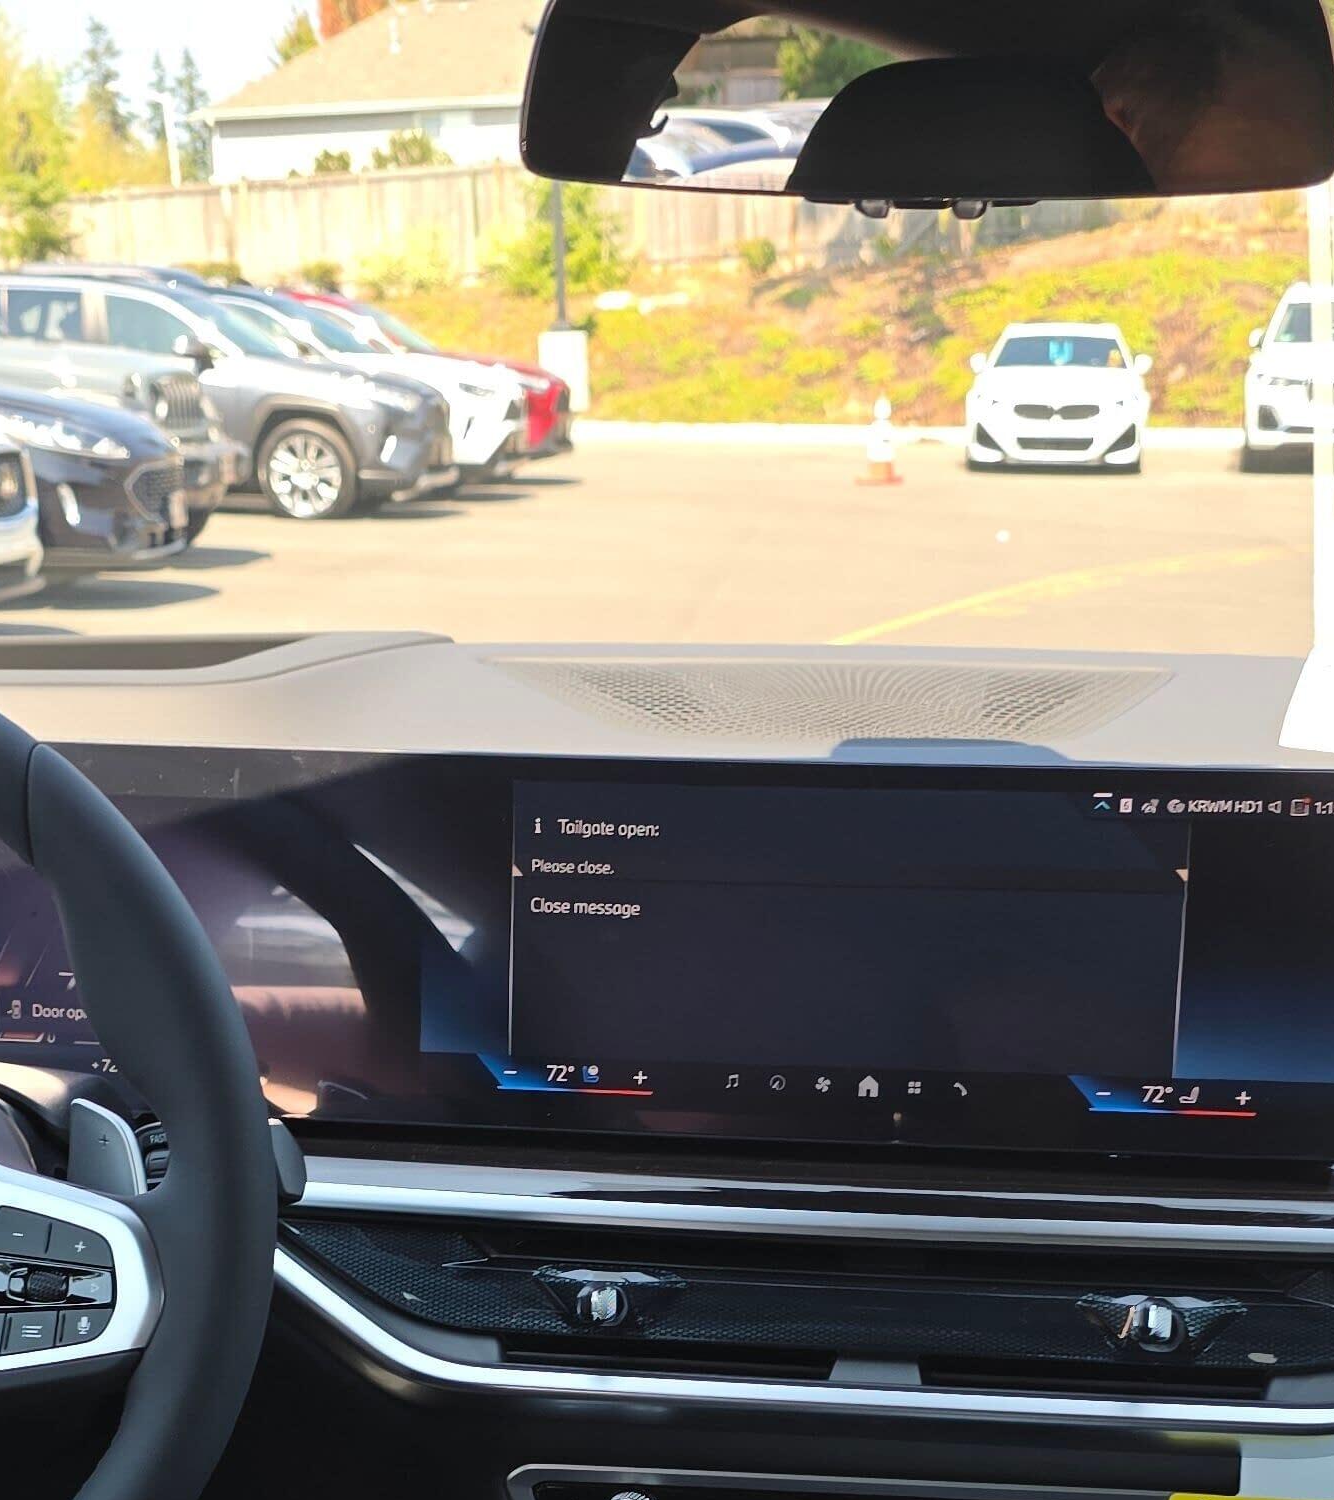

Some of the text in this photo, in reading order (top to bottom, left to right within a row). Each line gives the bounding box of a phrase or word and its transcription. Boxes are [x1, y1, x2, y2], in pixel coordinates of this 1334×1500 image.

[557, 818, 660, 839] Tailgate open:
[531, 859, 615, 875] Please close.
[530, 897, 641, 919] Close message
[32, 1003, 65, 1018] Door
